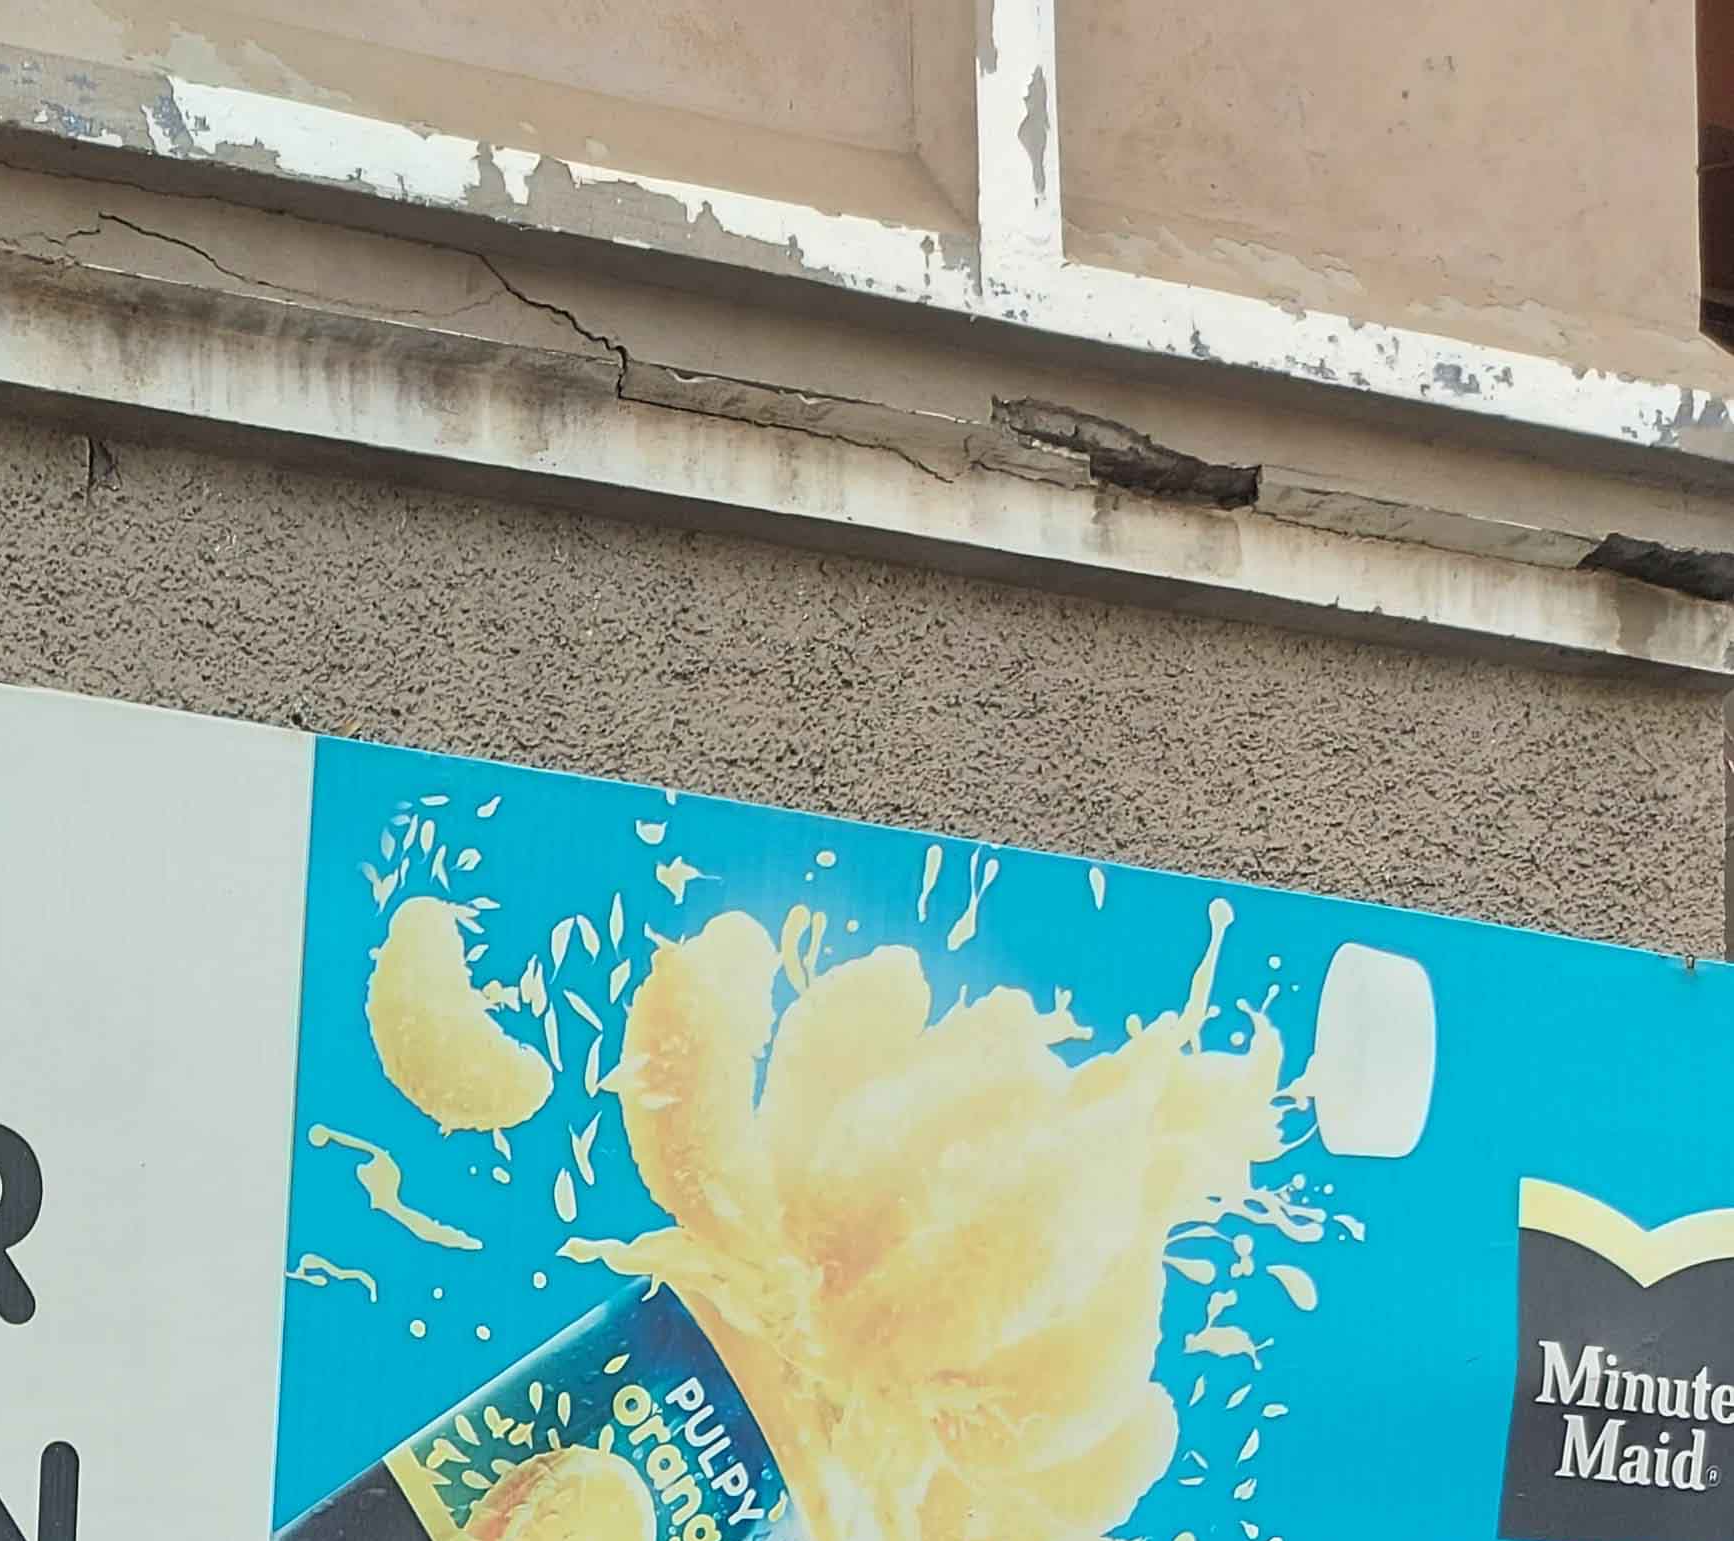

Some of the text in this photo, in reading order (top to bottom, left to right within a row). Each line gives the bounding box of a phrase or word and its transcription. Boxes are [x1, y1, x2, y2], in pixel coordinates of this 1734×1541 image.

[1534, 1340, 1734, 1425] Minute
[665, 1376, 765, 1527] PULPY
[1554, 1412, 1708, 1492] Maid
